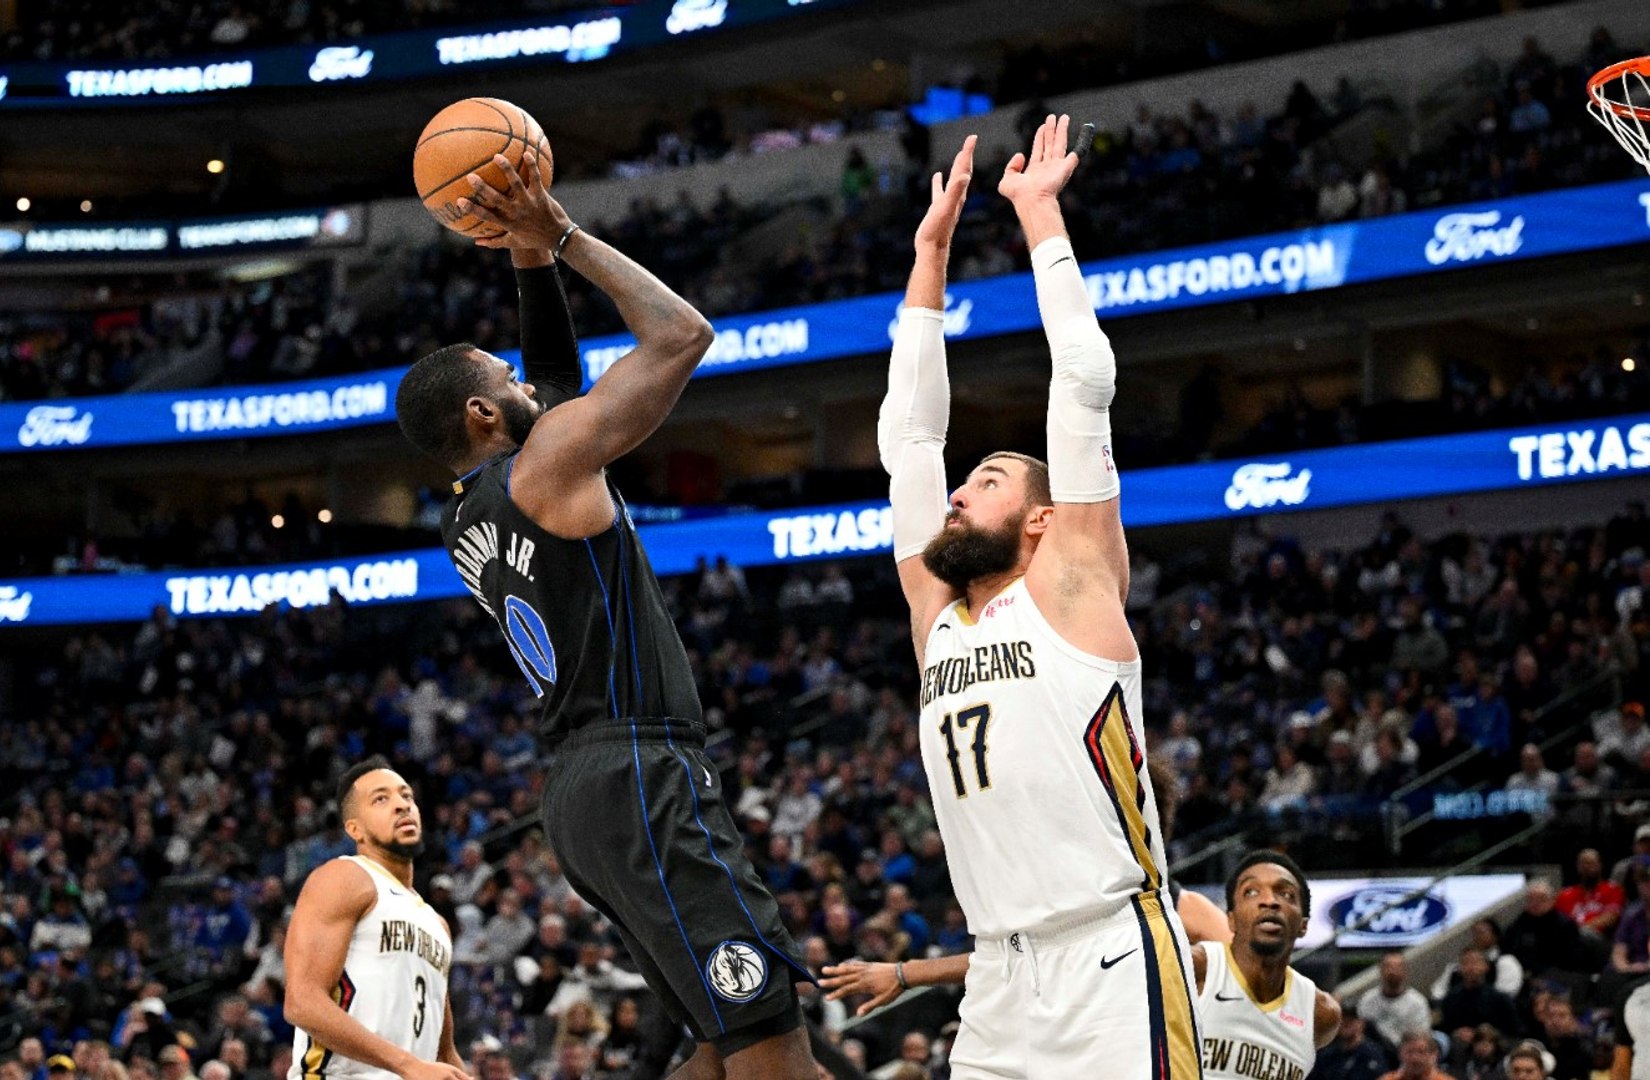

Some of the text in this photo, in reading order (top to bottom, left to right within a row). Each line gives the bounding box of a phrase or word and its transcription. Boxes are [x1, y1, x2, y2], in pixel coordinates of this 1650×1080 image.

[66, 61, 253, 97] TEXASFORD.COM
[309, 46, 374, 82] Ford
[1424, 210, 1524, 265] Ford
[1084, 239, 1335, 309] EXASFORD.COM
[18, 405, 94, 448] Ford
[172, 381, 388, 432] TEXASFORD.COM
[1509, 422, 1650, 480] TEXAS
[1224, 463, 1313, 511] Ford
[506, 532, 535, 582] JR.
[939, 703, 991, 800] 17
[1345, 890, 1428, 932] Ford
[380, 920, 416, 953] NEW
[413, 975, 426, 1039] 3
[1203, 1036, 1234, 1072] EW
